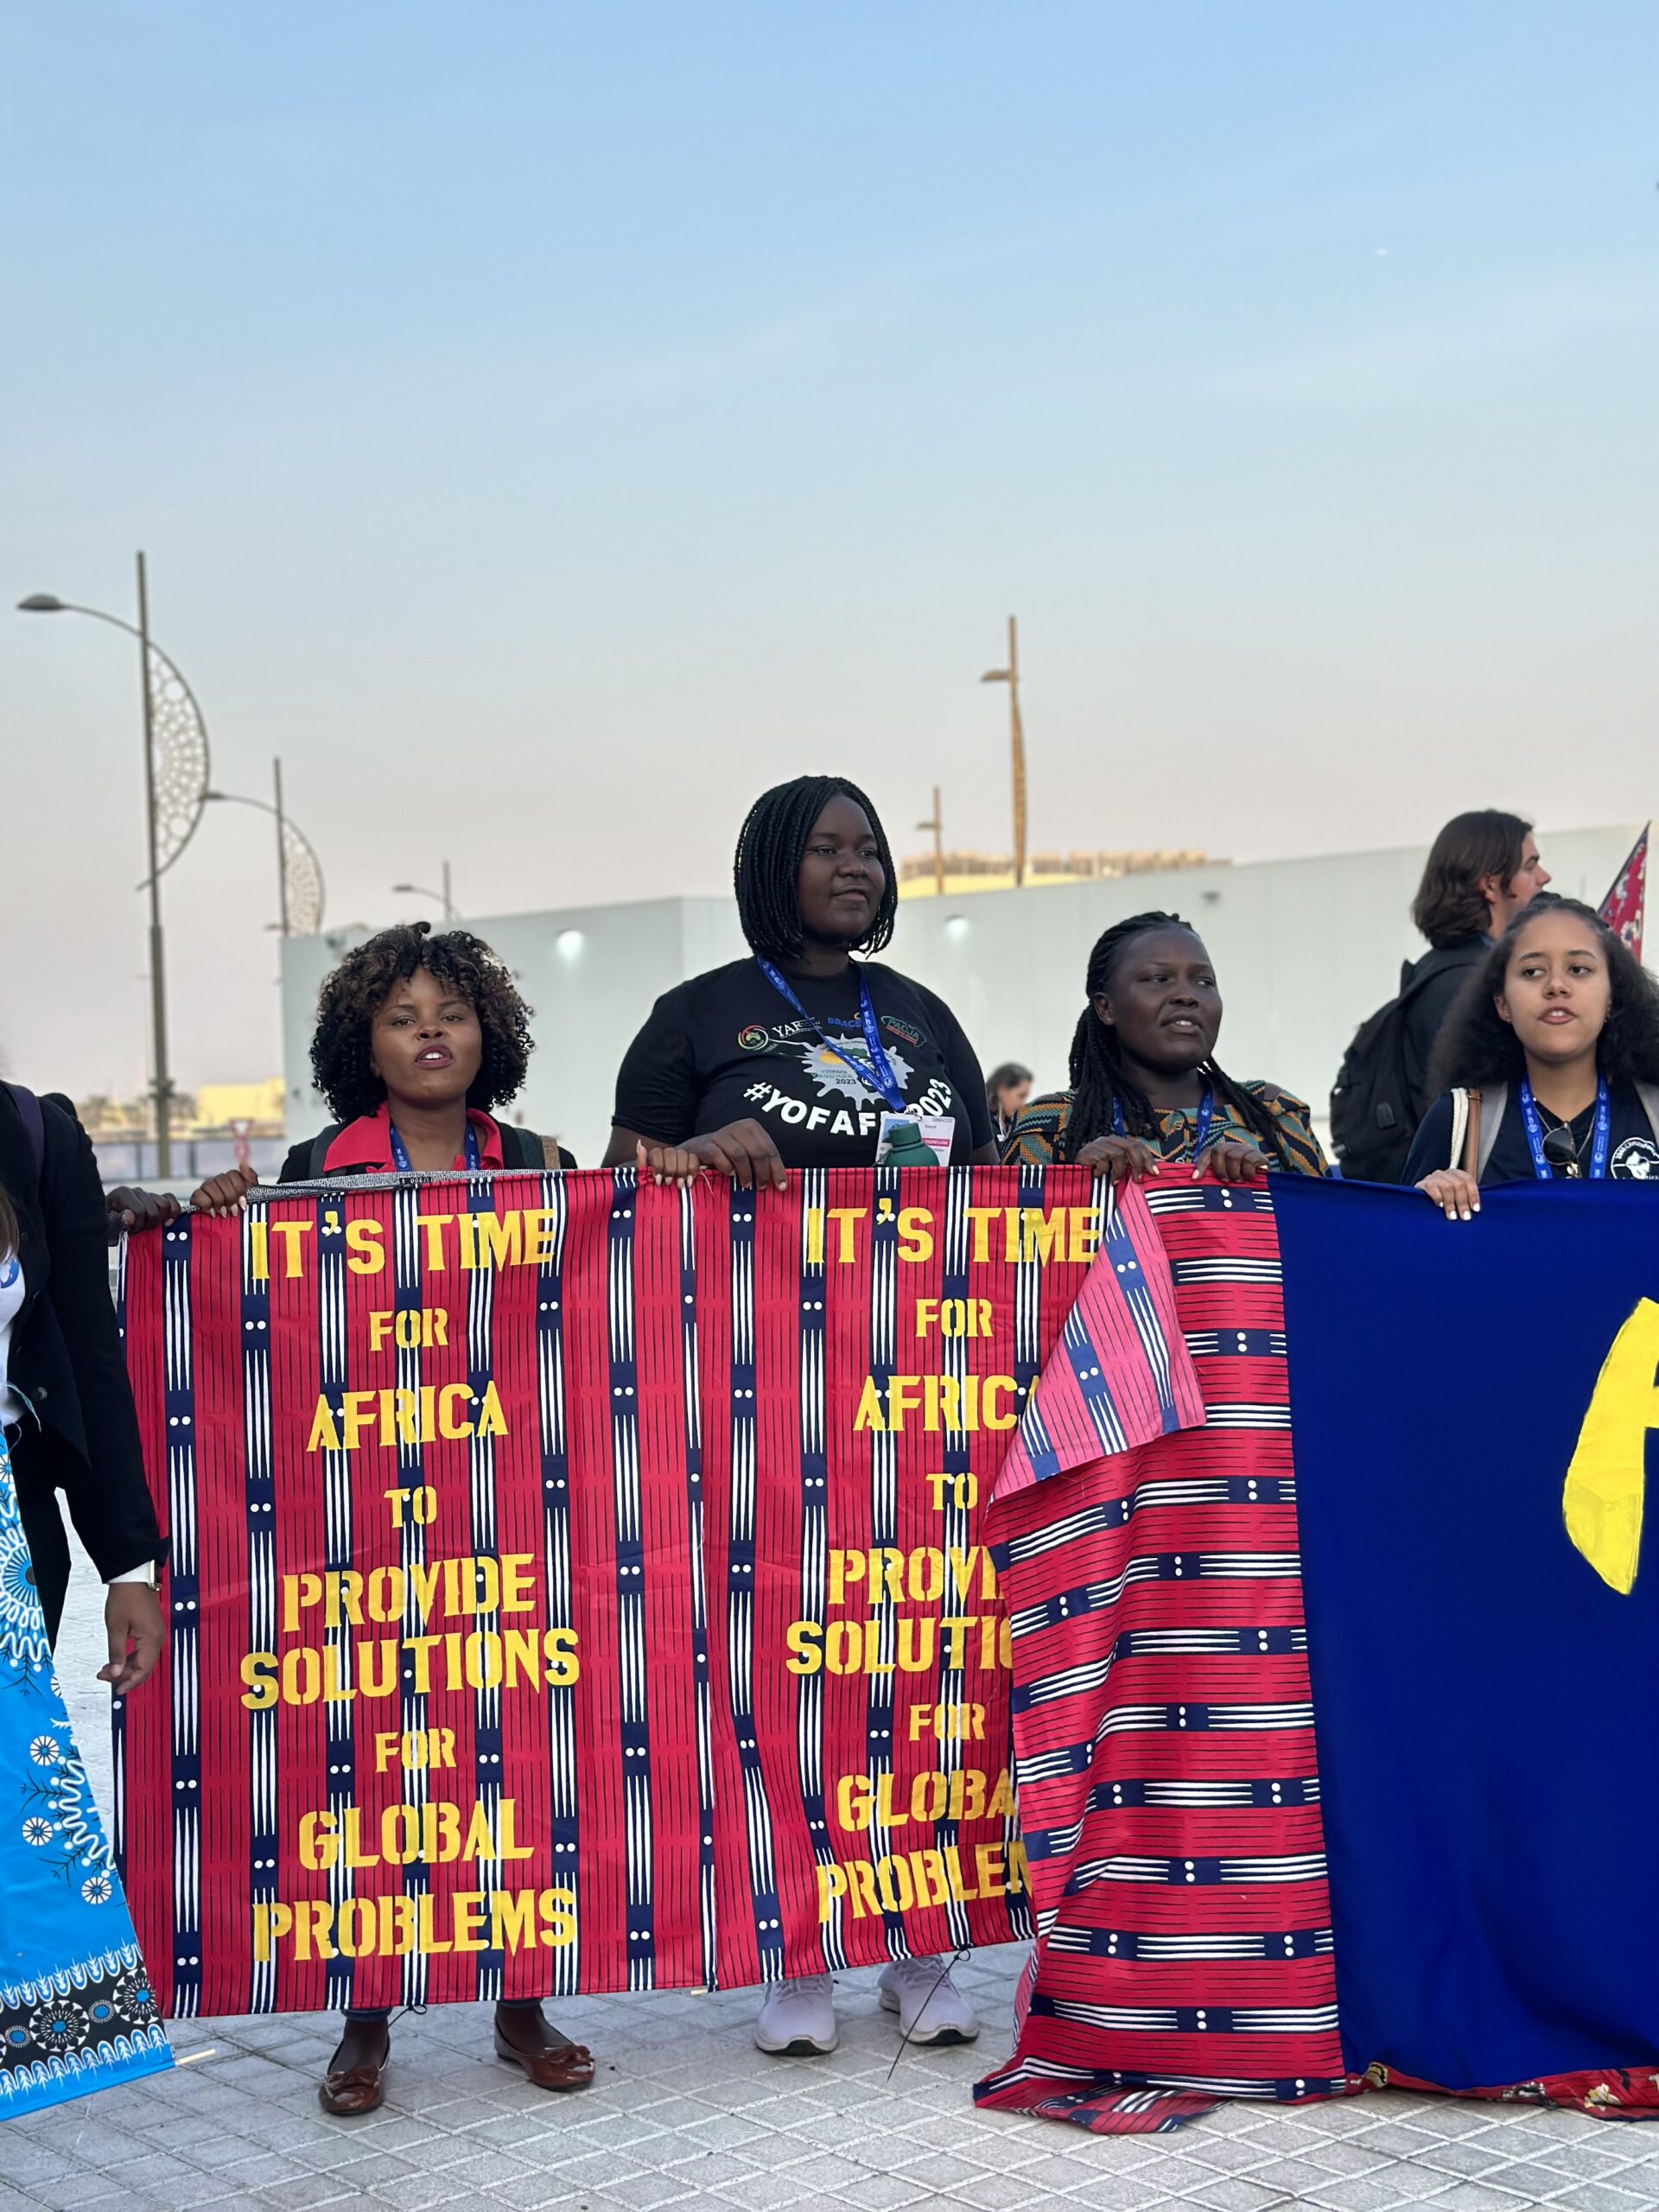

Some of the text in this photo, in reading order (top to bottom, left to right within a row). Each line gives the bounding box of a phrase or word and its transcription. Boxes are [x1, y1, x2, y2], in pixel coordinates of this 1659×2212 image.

[743, 1078, 951, 1136] #YOFAF2023
[250, 1209, 556, 1280] IT'S TIME
[807, 1198, 1101, 1267] IT'S TIME
[369, 1307, 448, 1351] FOR
[915, 1299, 994, 1338] FOR
[306, 1380, 509, 1452] AFRICA
[853, 1375, 1039, 1431] AFRIC
[384, 1485, 437, 1529] TO
[926, 1472, 978, 1510] TO
[283, 1553, 537, 1633] PROVIDE
[828, 1546, 1005, 1605] PROVI
[240, 1627, 581, 1710] SOLUTIONS
[375, 1728, 456, 1772] FOR
[908, 1702, 985, 1741] FOR
[836, 1767, 1017, 1833] GLOBA
[299, 1798, 534, 1871] GLOBAL
[252, 1888, 576, 1963] PROBLEMS
